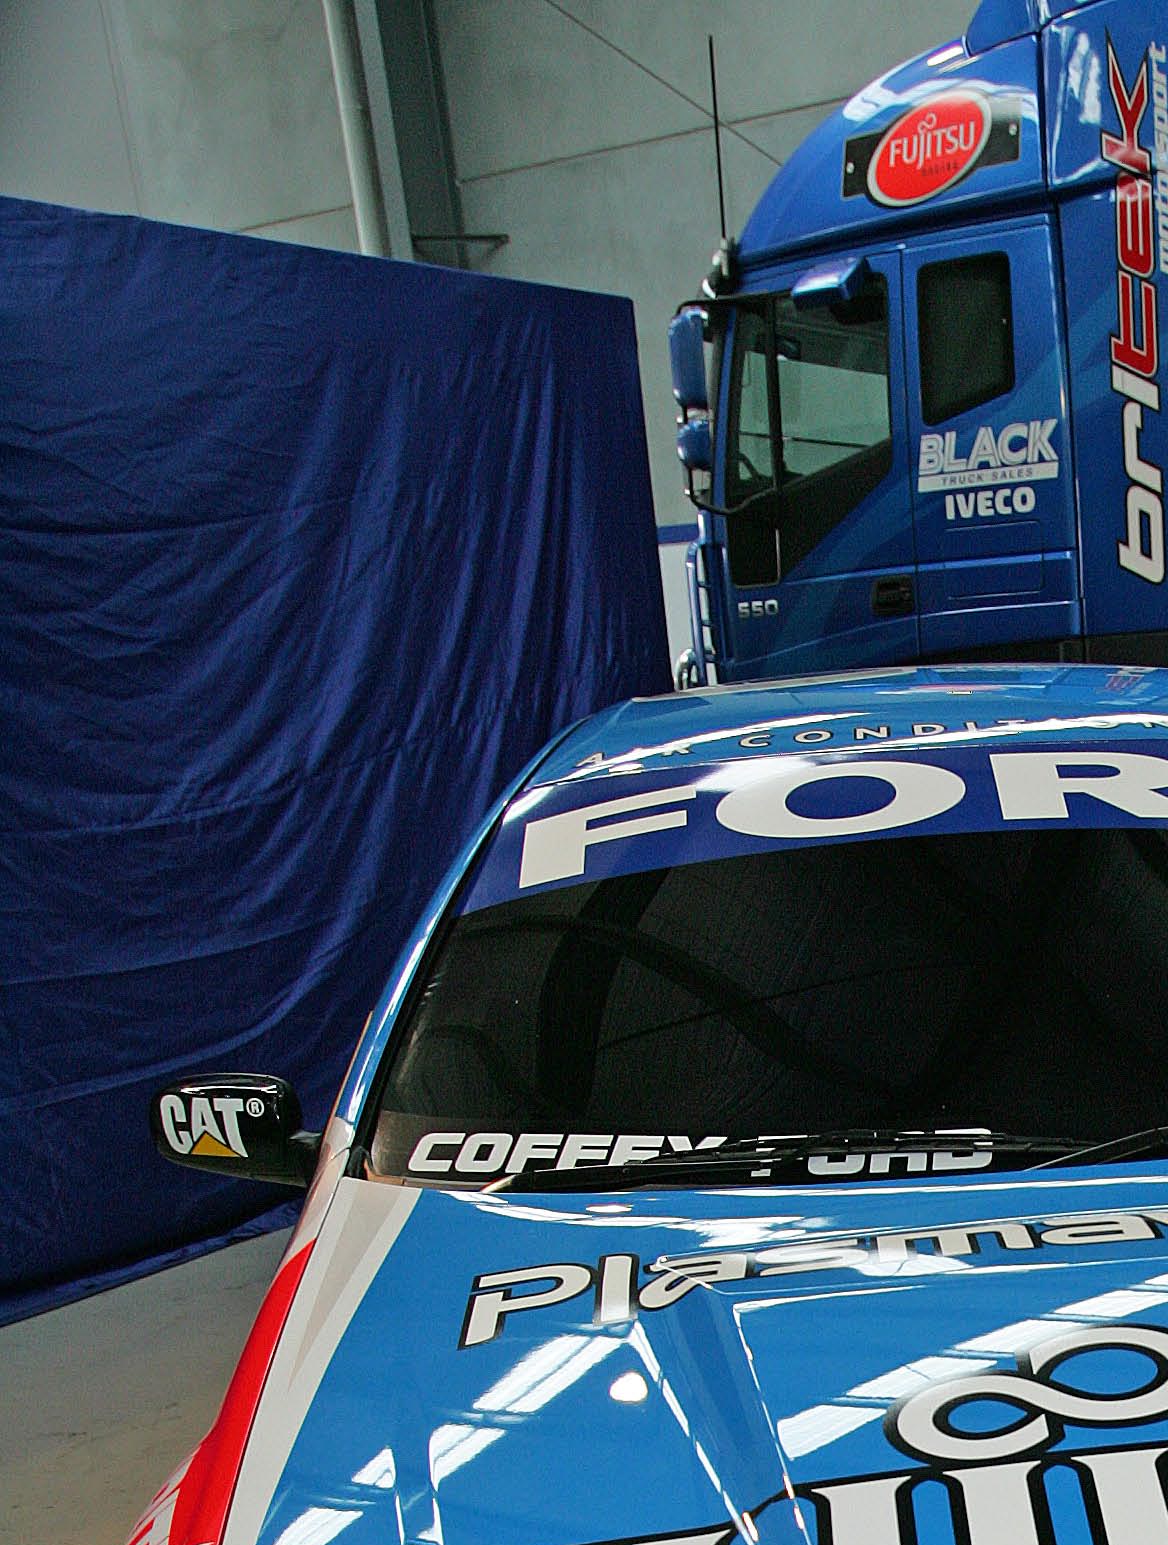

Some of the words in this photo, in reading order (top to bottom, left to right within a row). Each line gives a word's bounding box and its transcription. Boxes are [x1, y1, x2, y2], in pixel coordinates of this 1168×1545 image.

[889, 112, 976, 171] FUJITSU
[919, 419, 1059, 475] BLACK
[941, 474, 986, 487] TRUCK
[991, 467, 1034, 482] SALES
[945, 486, 1036, 520] IVECO
[737, 599, 779, 618] 550
